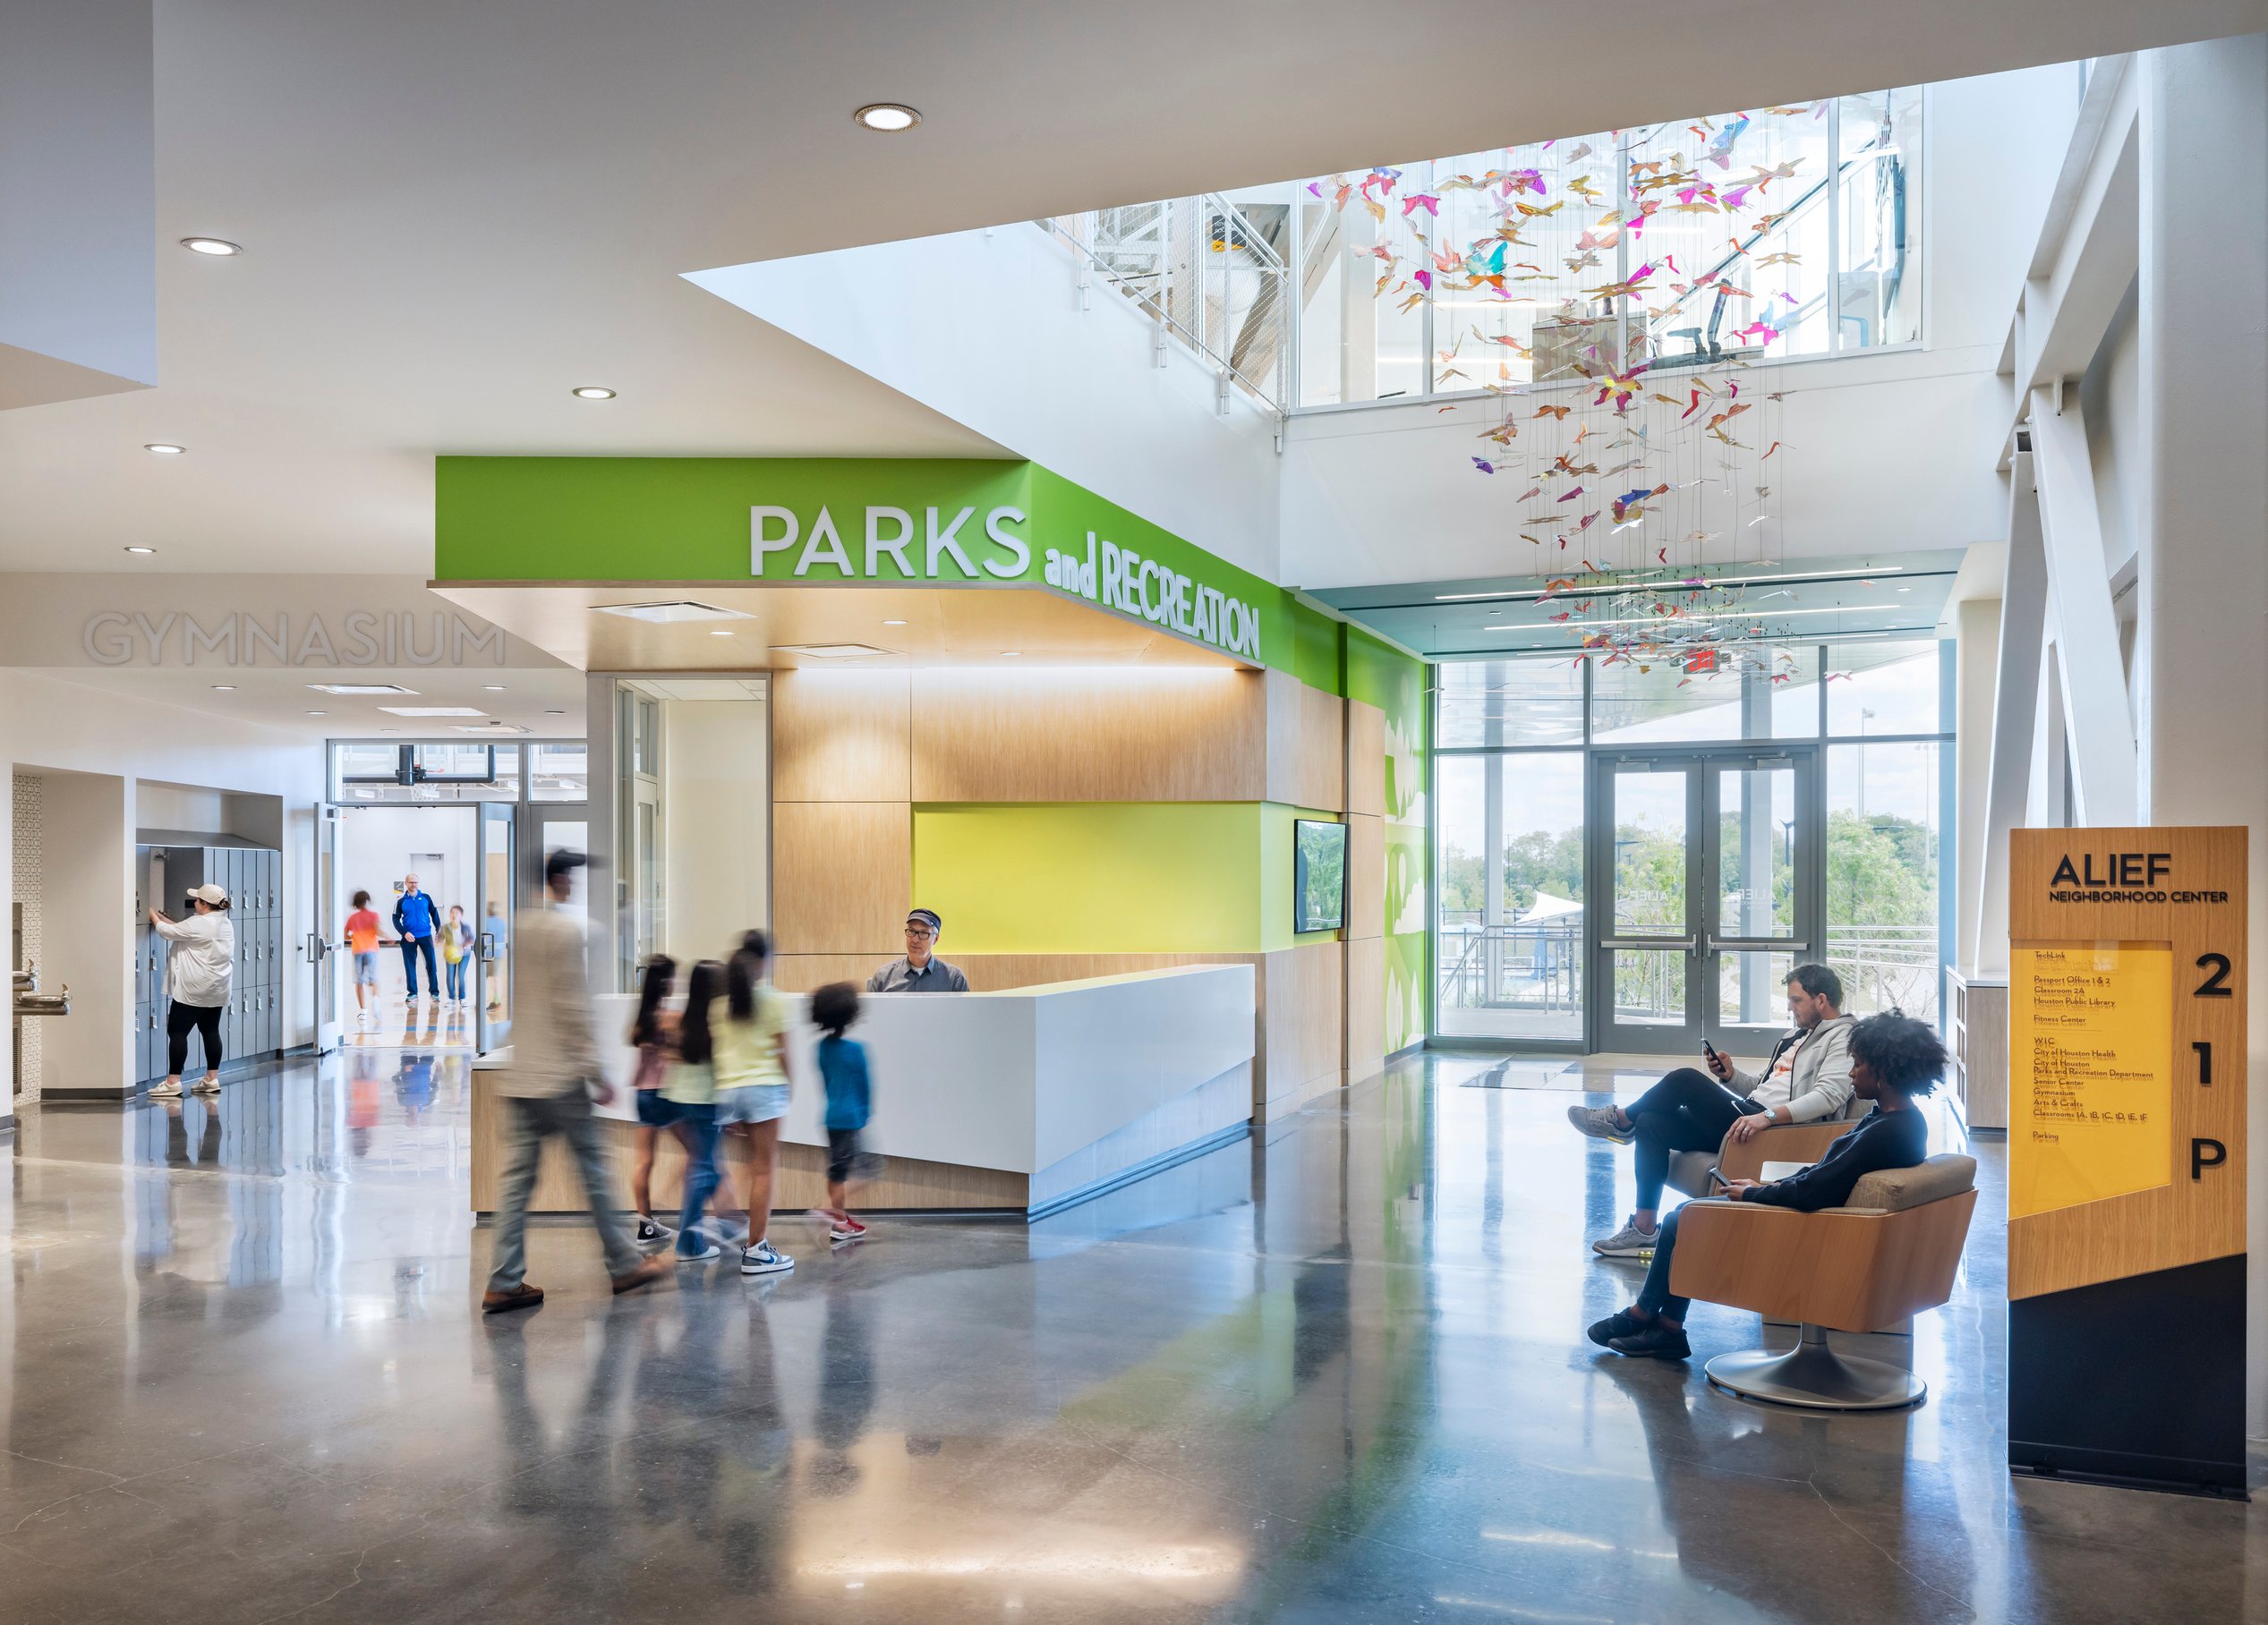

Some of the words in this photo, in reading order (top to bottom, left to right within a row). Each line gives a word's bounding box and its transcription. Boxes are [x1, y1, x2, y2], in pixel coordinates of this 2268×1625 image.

[750, 504, 1031, 578] PARKS
[1044, 531, 1096, 600] and
[1102, 540, 1260, 659] RECREATION
[82, 611, 507, 667] GYMNASIUM
[2051, 854, 2171, 887] ALIEF
[2050, 891, 2167, 903] NEIGHBORHOOD
[2171, 891, 2229, 904] CENTER
[2034, 951, 2066, 959] TechLink
[2034, 975, 2065, 985] Passport
[2194, 953, 2232, 997] 2
[2089, 999, 2115, 1007] Library
[2034, 1048, 2050, 1056] City
[2192, 1042, 2212, 1084] 1
[2110, 1069, 2153, 1078] Department
[2034, 1088, 2075, 1096] Gymnasium
[2033, 1131, 2059, 1141] Parking
[2191, 1138, 2226, 1179] P
